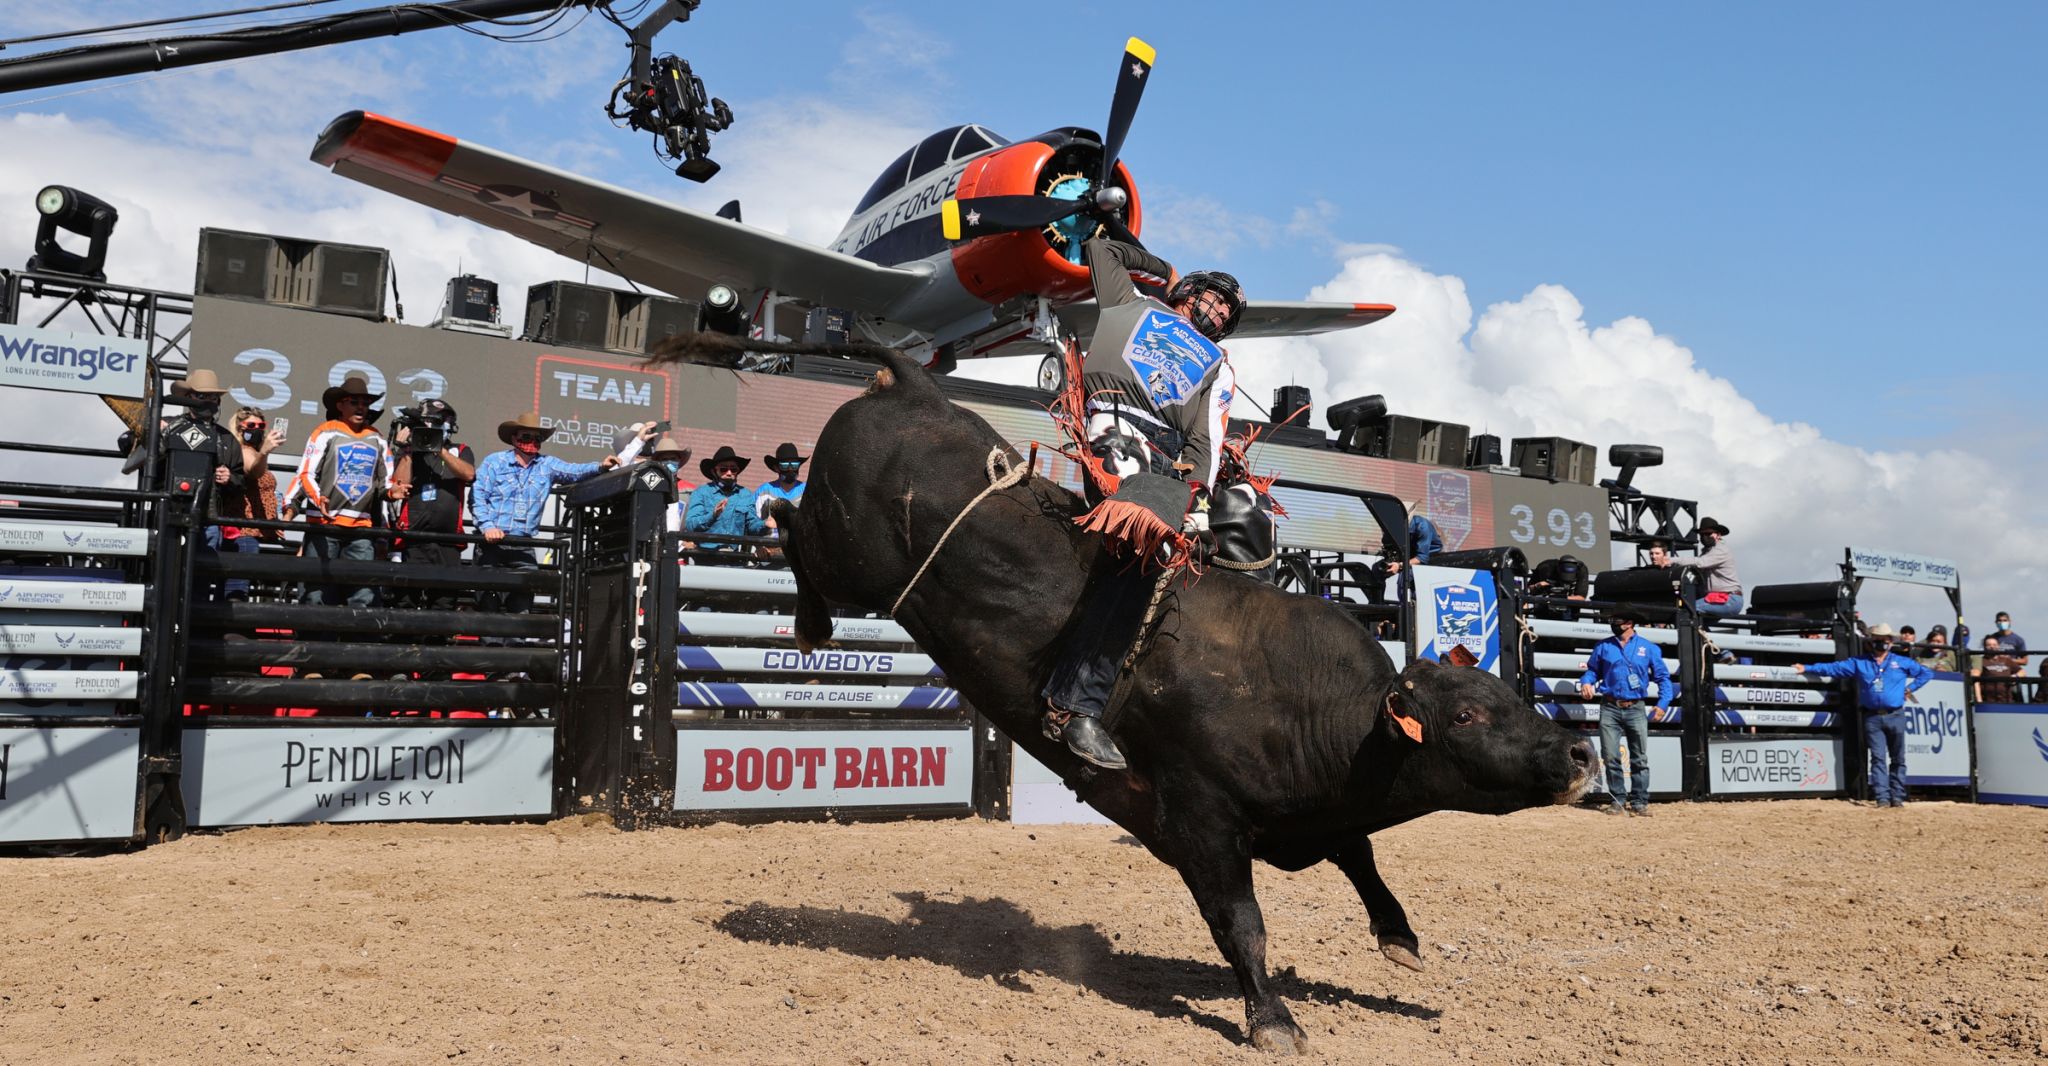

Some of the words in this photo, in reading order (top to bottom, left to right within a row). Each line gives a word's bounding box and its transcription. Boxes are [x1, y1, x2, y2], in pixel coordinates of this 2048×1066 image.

[855, 215, 888, 250] AIR
[891, 170, 965, 230] FORCE
[0, 335, 138, 380] Wrangler
[6, 366, 23, 375] LONG
[25, 368, 40, 377] LIVE
[42, 369, 75, 379] COWBOYS
[1132, 347, 1190, 392] COWBOYS
[554, 371, 651, 407] TEAM
[540, 417, 581, 432] BAD
[1510, 504, 1596, 549] 3.93
[0, 529, 43, 541] PENDLETON
[1854, 552, 1886, 572] Wrangler
[1890, 557, 1921, 577] Wrangler
[1925, 562, 1954, 581] Wrangler
[82, 589, 126, 600] PENDLETON
[0, 632, 35, 643] NDLETON
[1440, 636, 1481, 646] COWBOYS
[763, 651, 893, 672] COWBOYS
[76, 677, 120, 688] PENDLETON
[785, 691, 812, 701] FOR
[816, 692, 825, 701] A
[829, 692, 874, 702] CAUSE
[1747, 690, 1805, 703] COWBOYS
[1778, 714, 1798, 722] CAUSE
[1904, 701, 1963, 754] angler
[281, 739, 464, 788] PENDLETON
[1721, 749, 1758, 764] BAD
[1765, 749, 1799, 764] BOY
[703, 747, 826, 792] BOOT
[834, 746, 947, 789] BARN
[1721, 766, 1802, 782] MOWERS
[316, 791, 434, 808] WHISKY
